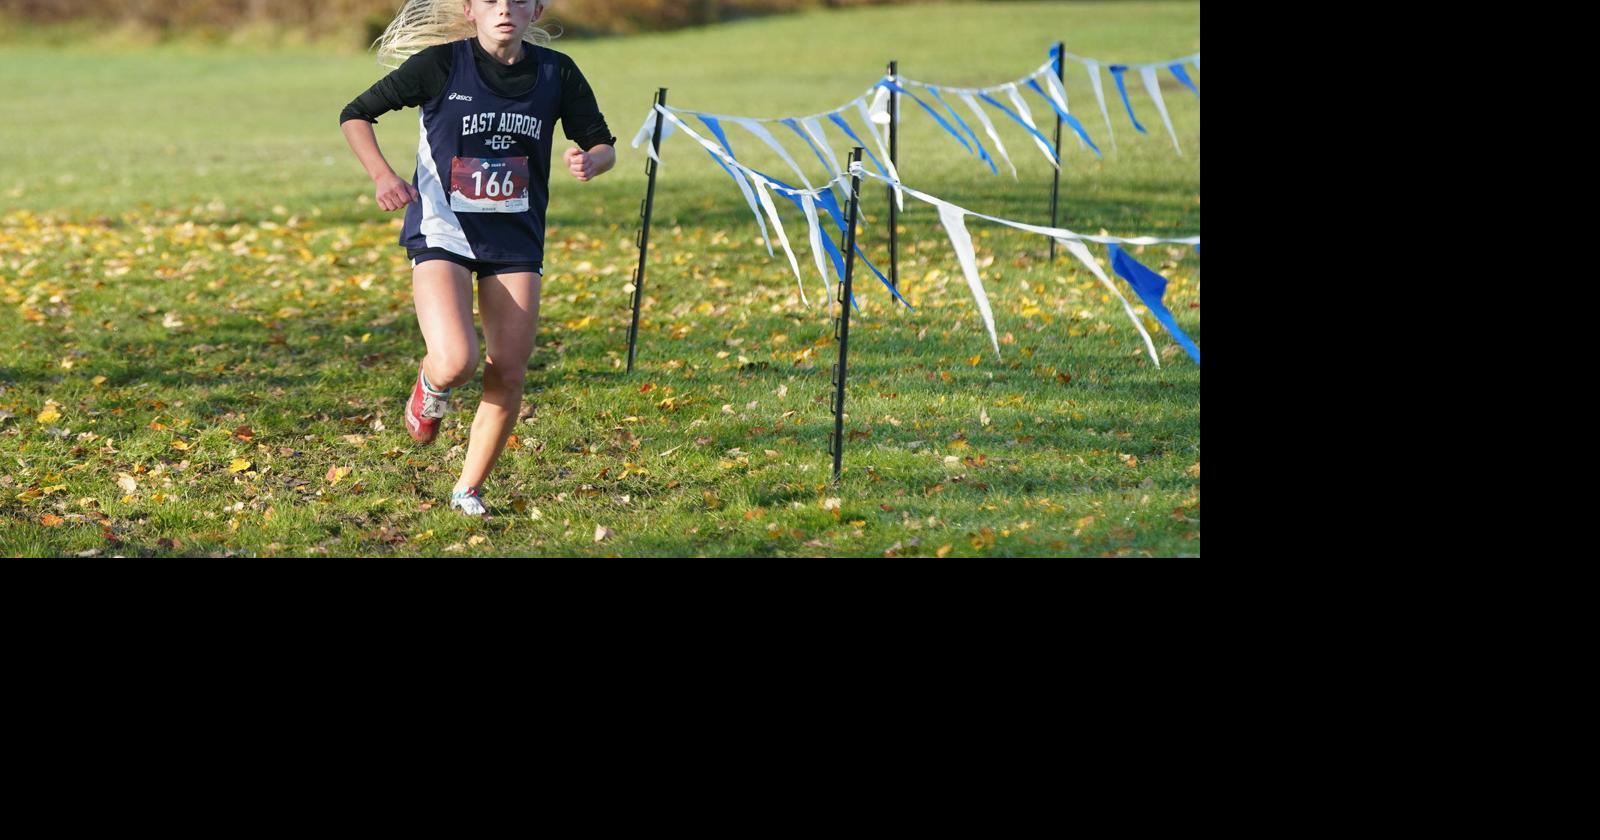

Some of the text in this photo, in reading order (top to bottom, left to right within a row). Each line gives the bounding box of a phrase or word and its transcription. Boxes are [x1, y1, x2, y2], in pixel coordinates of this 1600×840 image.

[462, 112, 542, 140] EAST AURORA
[491, 134, 512, 150] CC
[471, 170, 514, 197] 166
